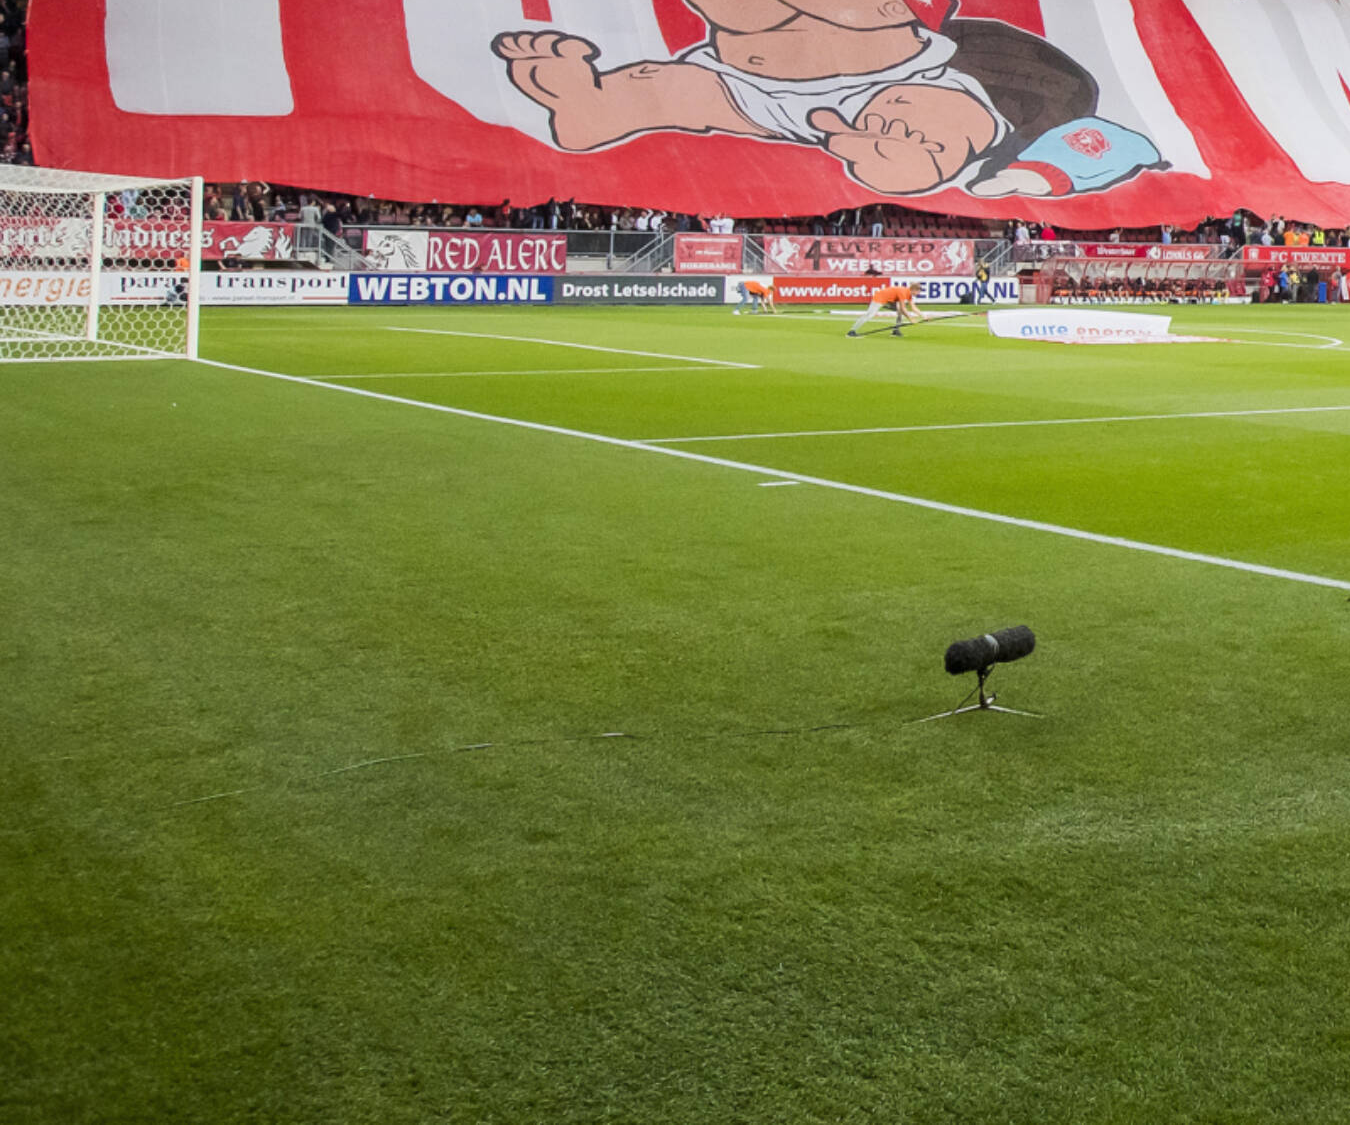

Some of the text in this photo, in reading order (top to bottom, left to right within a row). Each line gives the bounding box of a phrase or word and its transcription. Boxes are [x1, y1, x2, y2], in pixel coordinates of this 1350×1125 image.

[428, 236, 567, 271] RED ALERT
[892, 241, 936, 254] RED
[1270, 251, 1346, 264] FC TWENTE
[216, 273, 347, 293] transport
[357, 277, 546, 301] WEBTON.NL
[562, 281, 717, 298] Drost Letselschade
